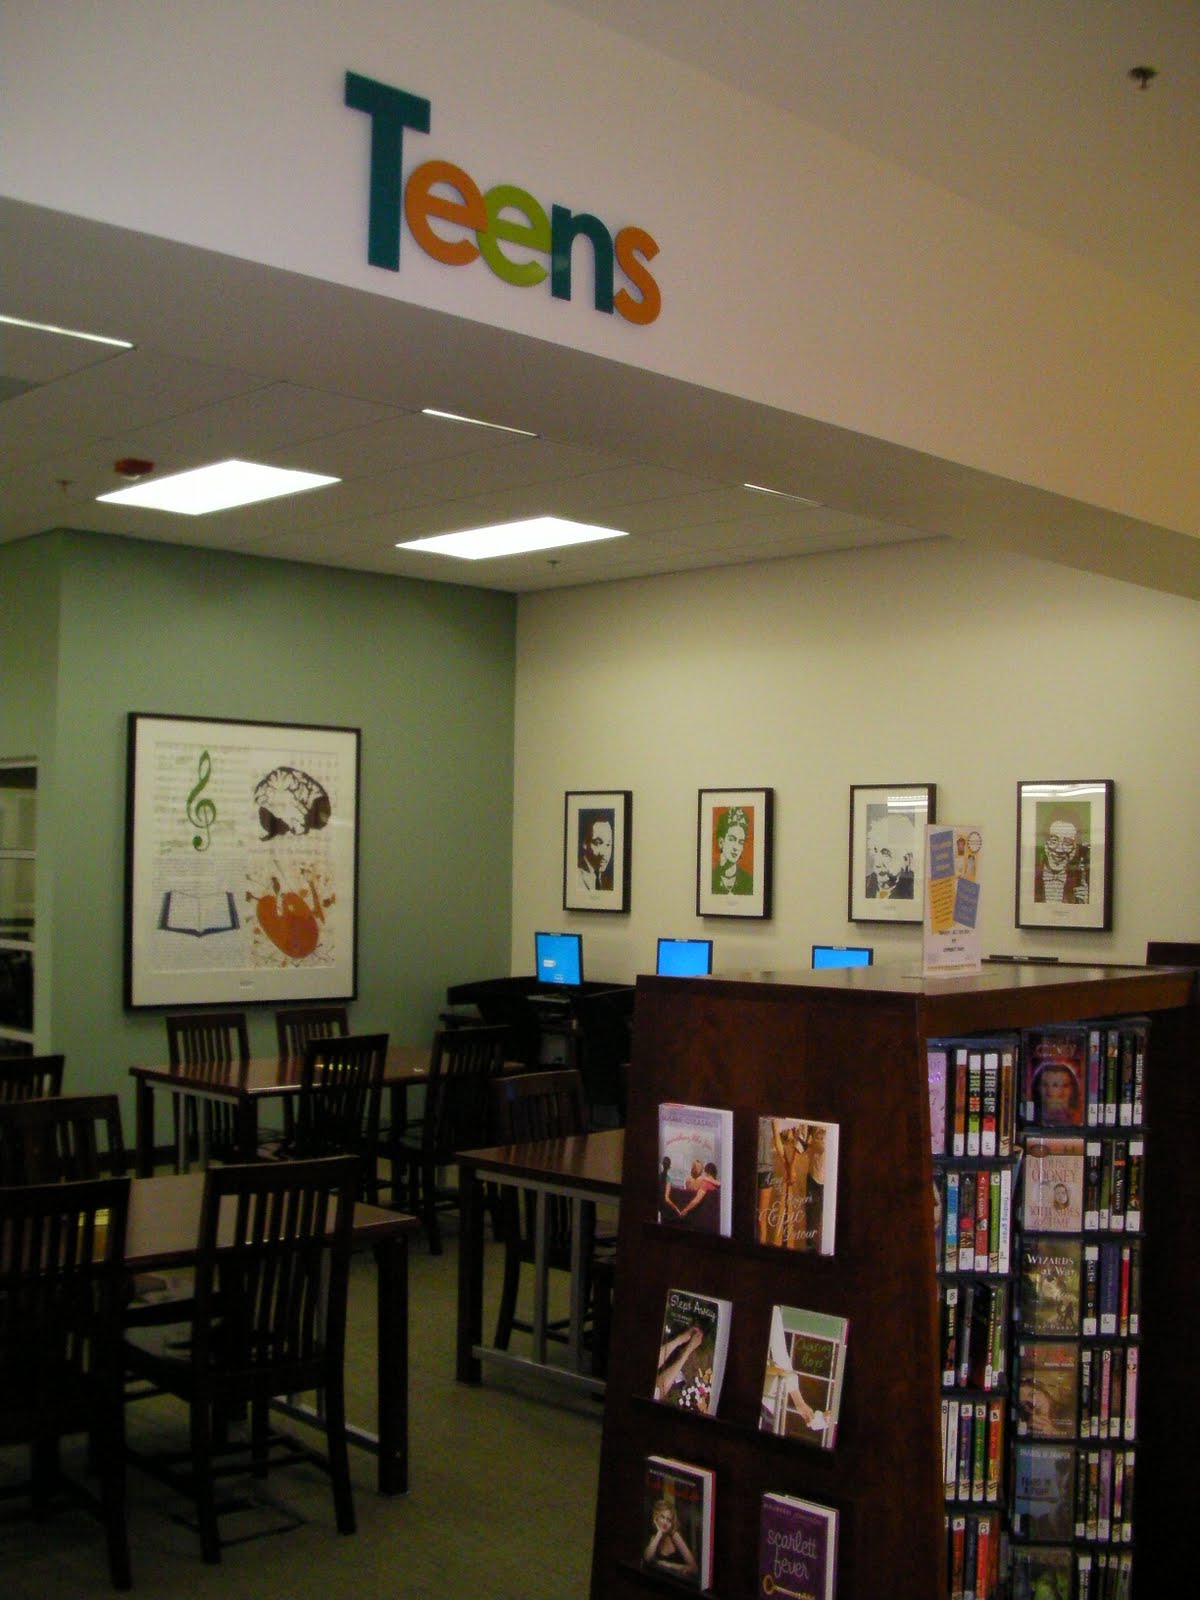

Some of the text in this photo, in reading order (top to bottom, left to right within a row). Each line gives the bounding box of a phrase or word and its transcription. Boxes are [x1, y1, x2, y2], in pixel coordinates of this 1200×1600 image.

[344, 70, 661, 326] Teens
[984, 1069, 996, 1113] FIRE-US
[760, 1201, 805, 1236] Epic
[1026, 1253, 1074, 1265] WIZARDS
[1054, 1266, 1075, 1276] War
[693, 1301, 717, 1322] Away
[767, 1529, 817, 1559] scarlett
[774, 1557, 809, 1580] fever
